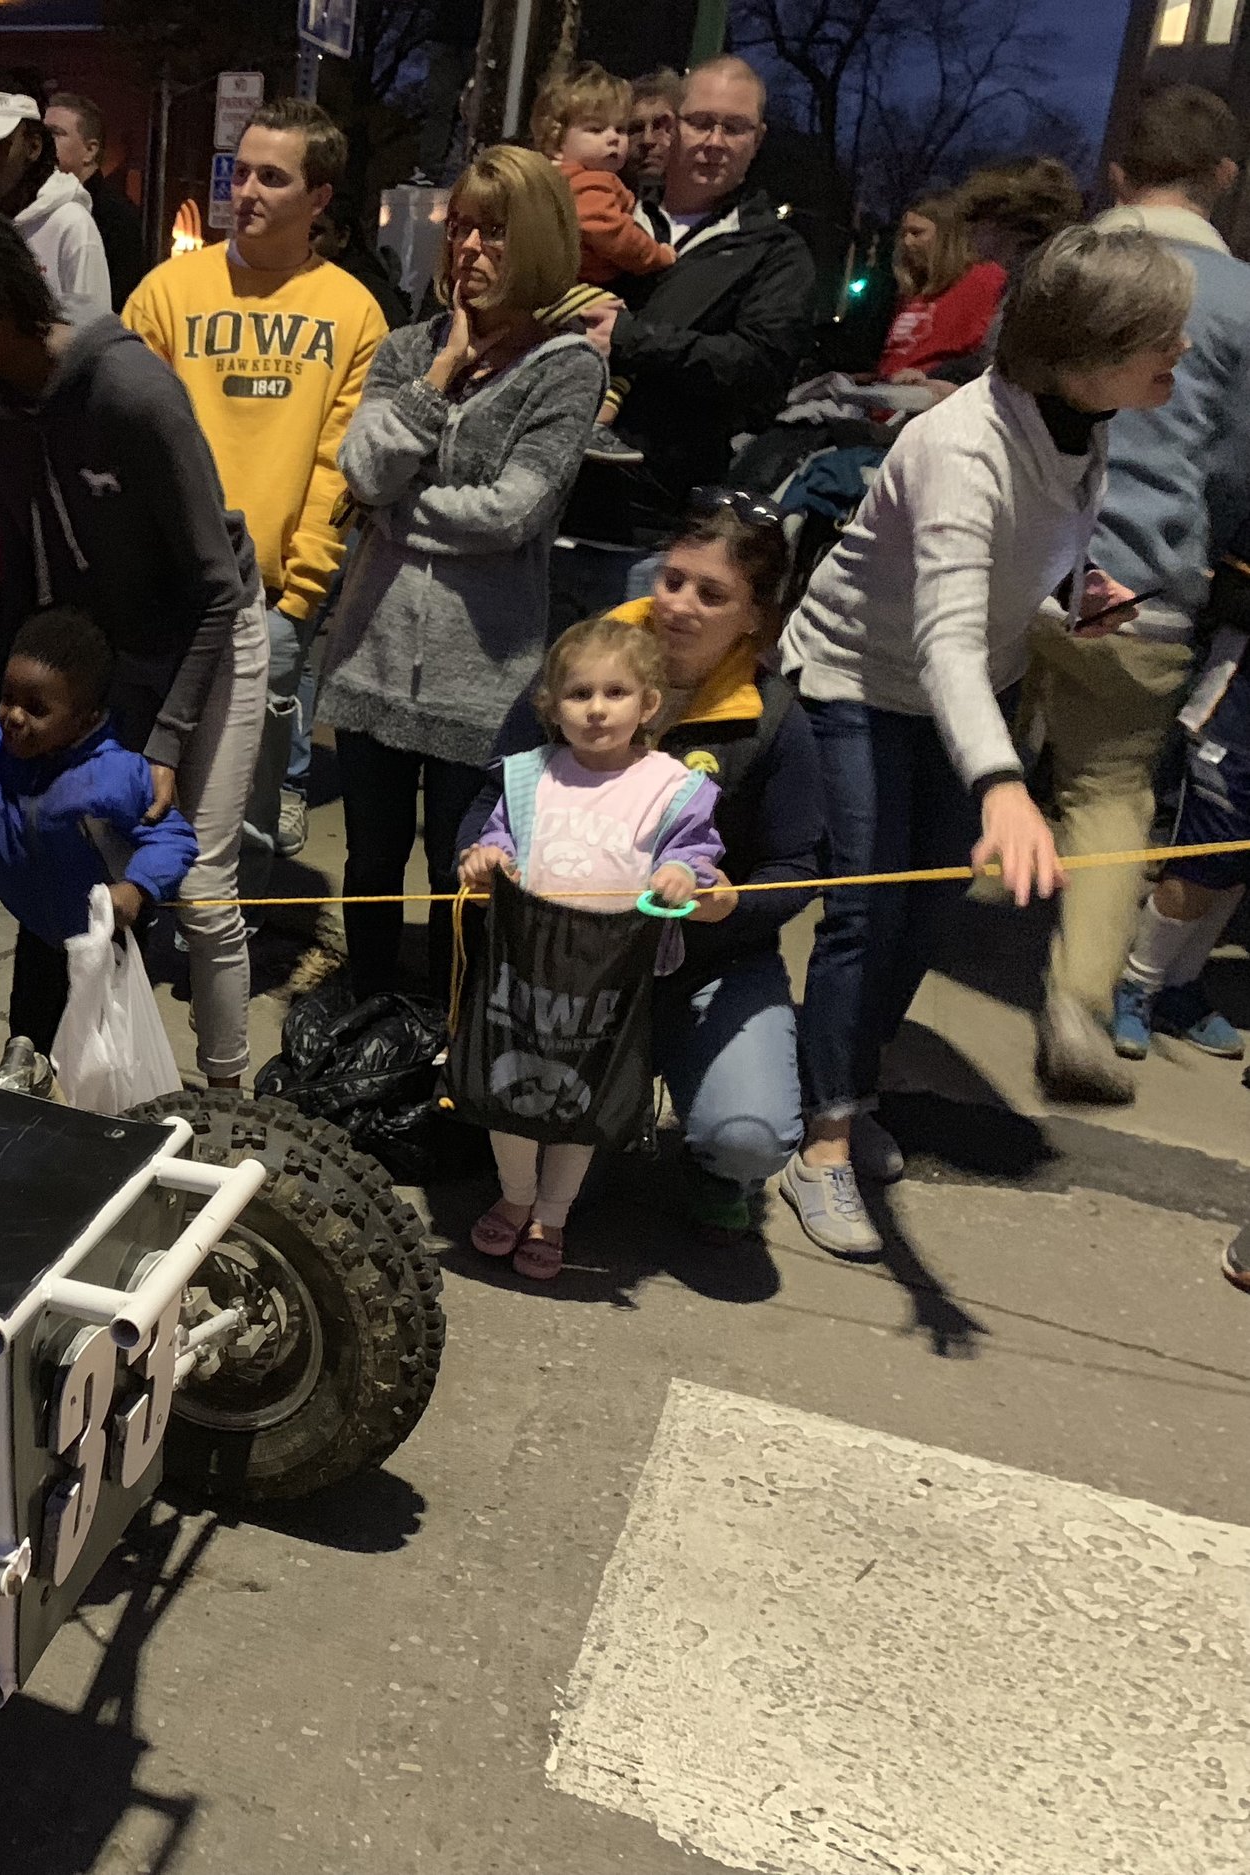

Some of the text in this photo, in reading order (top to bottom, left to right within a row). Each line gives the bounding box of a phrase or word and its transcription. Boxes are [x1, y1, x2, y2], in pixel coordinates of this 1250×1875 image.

[184, 310, 336, 371] IOWA
[215, 357, 304, 375] HAWKEYES
[251, 379, 287, 397] 1847
